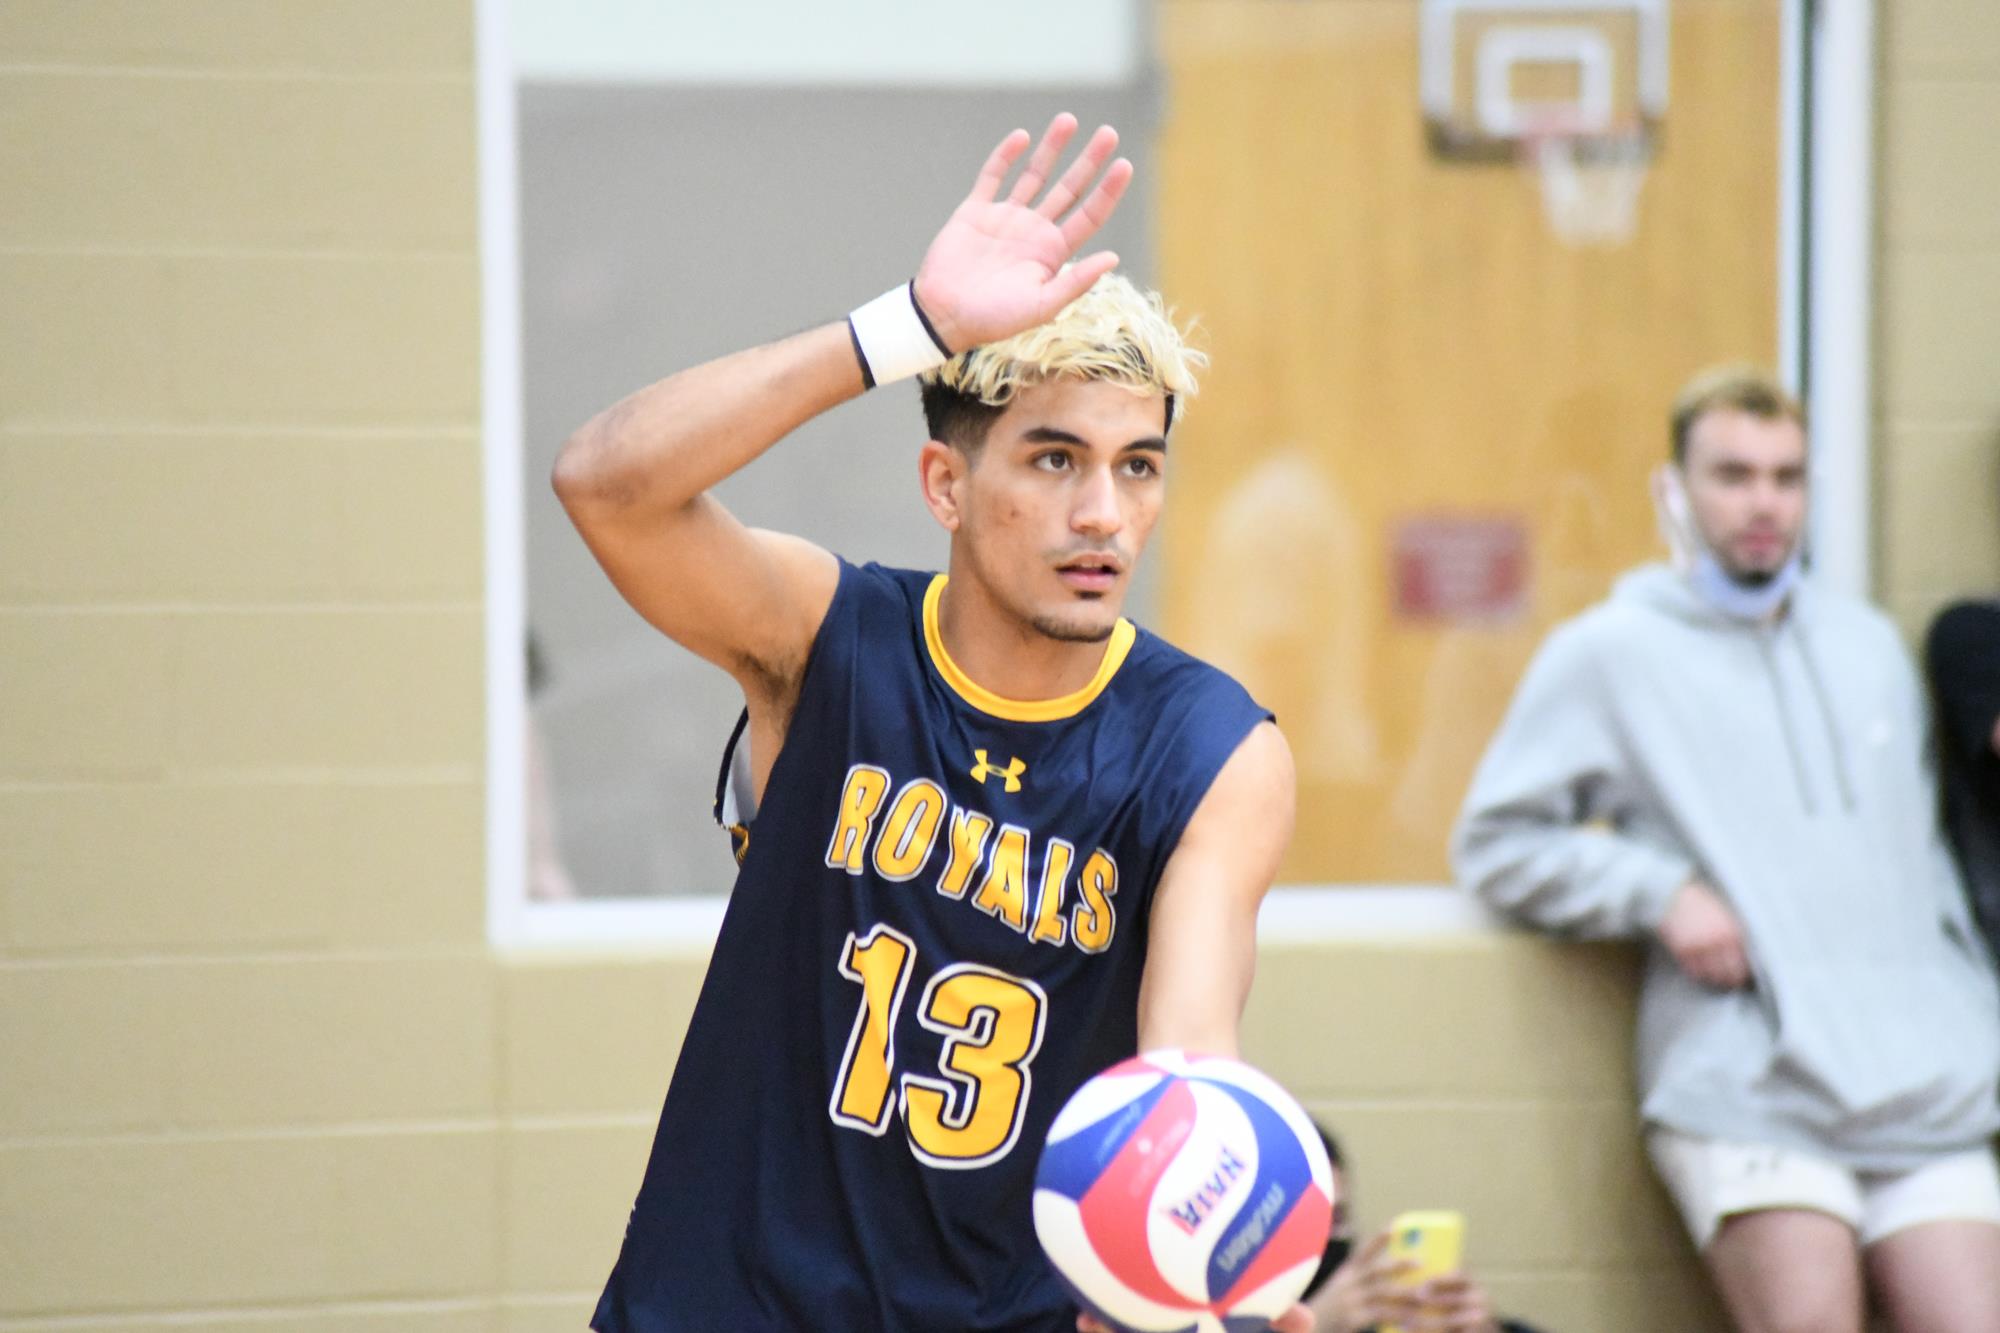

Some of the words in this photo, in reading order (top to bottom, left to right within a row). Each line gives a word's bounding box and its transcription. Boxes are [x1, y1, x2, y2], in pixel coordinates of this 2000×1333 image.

[825, 763, 1118, 954] ROYALS
[829, 923, 1048, 1169] 13
[1168, 1146, 1246, 1229] NAIA
